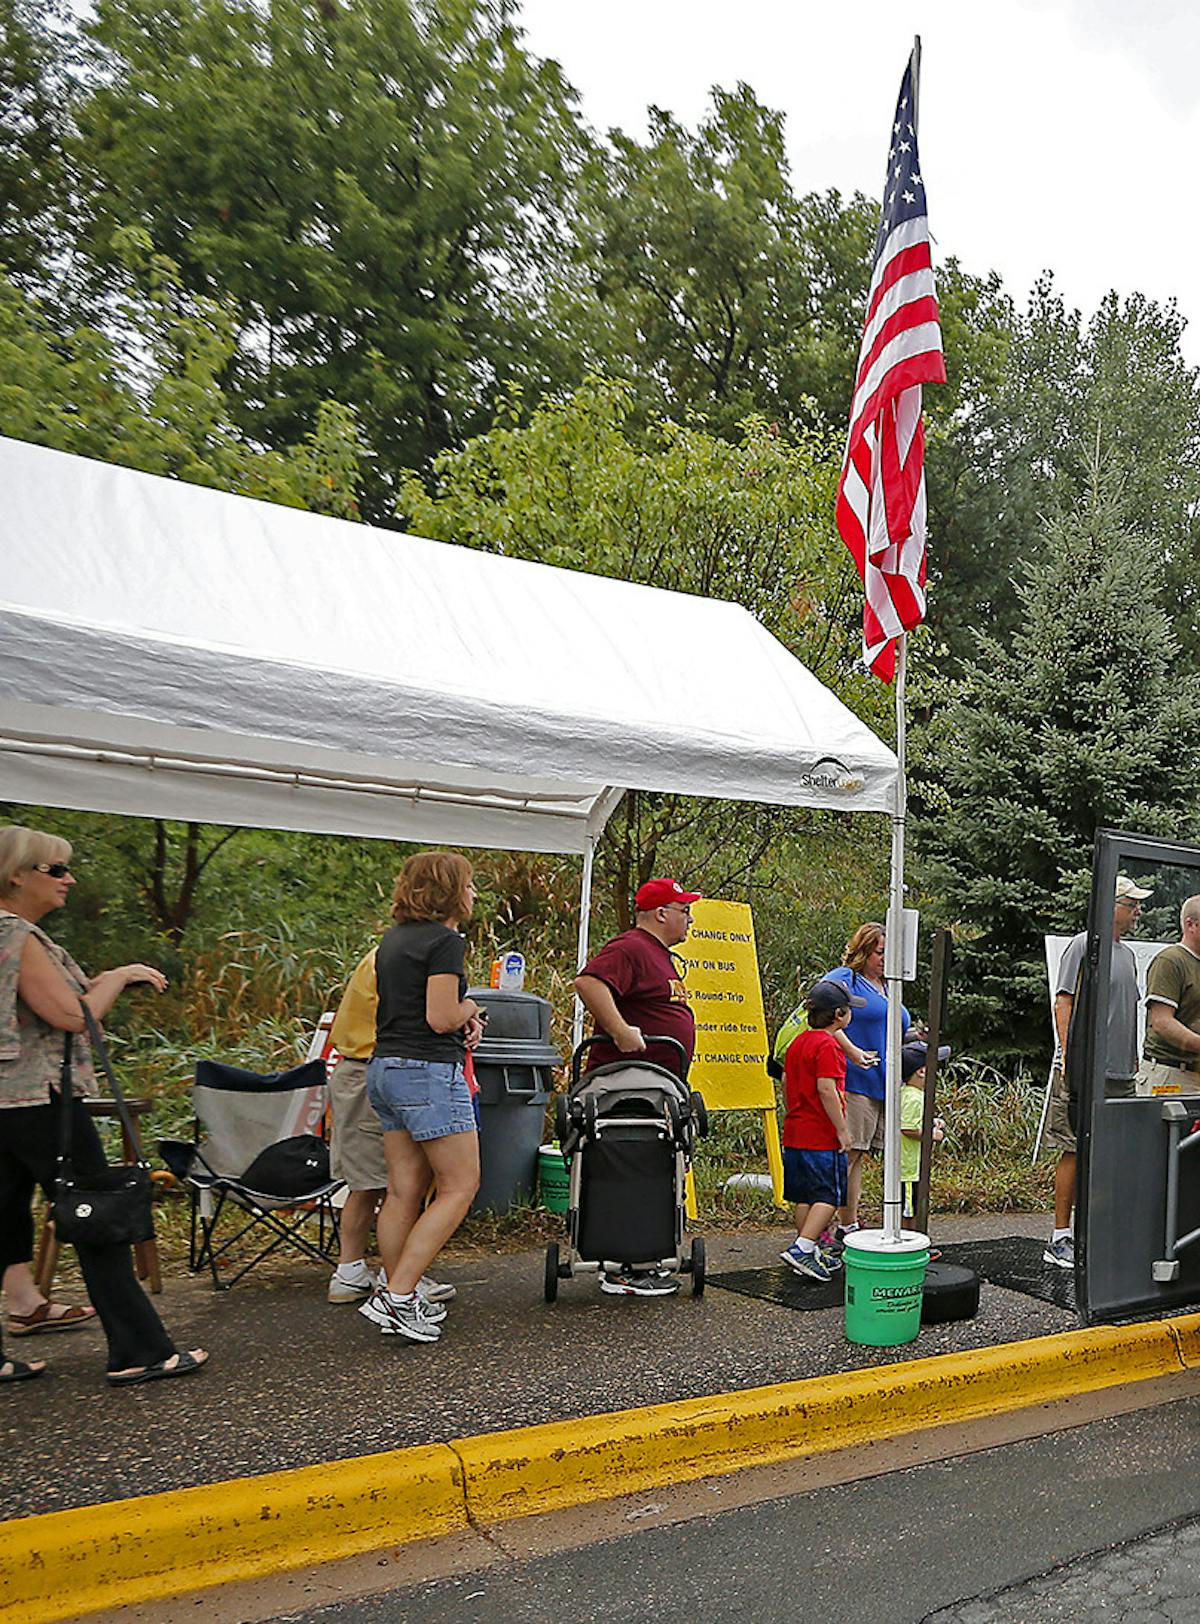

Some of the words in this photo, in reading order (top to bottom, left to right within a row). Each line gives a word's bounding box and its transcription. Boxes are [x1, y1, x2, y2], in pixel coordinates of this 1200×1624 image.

[691, 929, 727, 941] CHANGE
[729, 932, 752, 943] ONLY
[702, 960, 715, 970] ON
[718, 961, 736, 972] BUS
[695, 991, 744, 1003] Round-Trip
[720, 1021, 738, 1033] ride
[740, 1022, 758, 1033] free
[704, 1053, 741, 1064] CHANGE
[743, 1054, 765, 1064] ONLY
